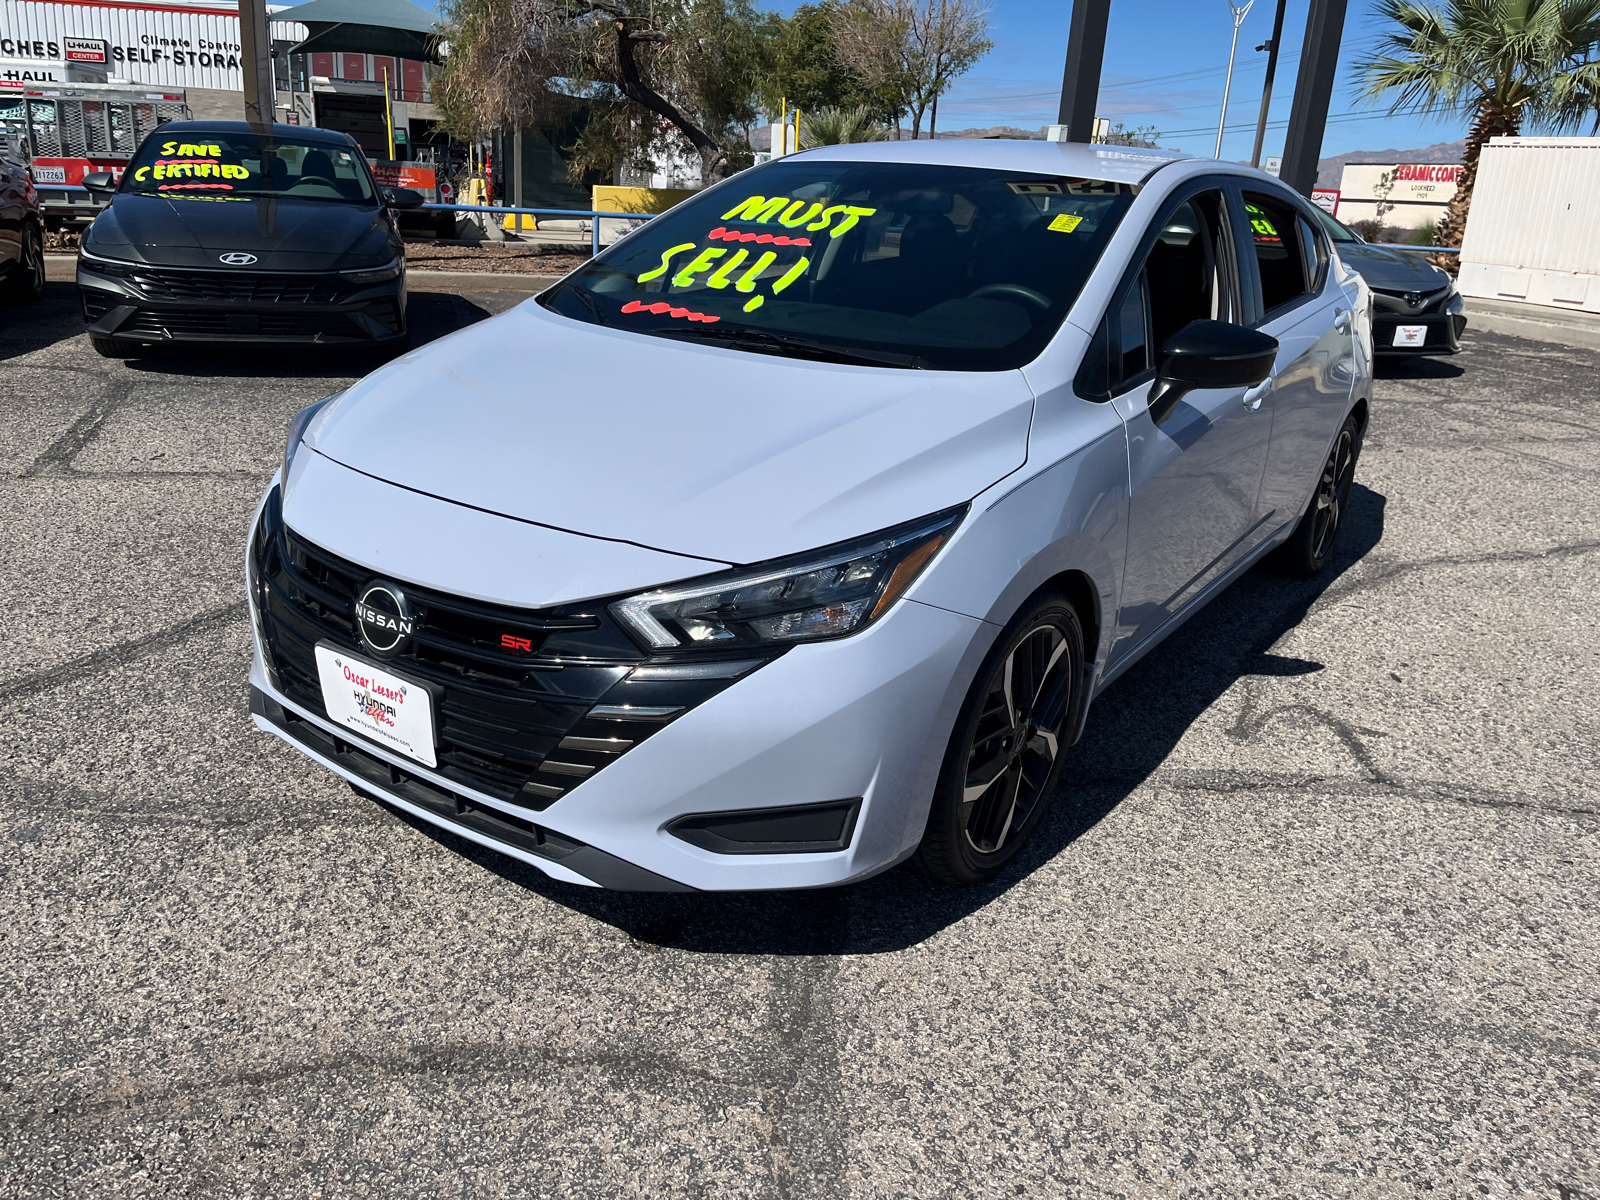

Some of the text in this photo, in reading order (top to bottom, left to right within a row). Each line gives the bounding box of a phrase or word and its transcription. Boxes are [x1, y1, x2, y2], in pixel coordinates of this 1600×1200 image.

[1, 38, 59, 57] CHES
[67, 41, 102, 50] U-HAUL
[141, 34, 190, 47] Climate
[72, 52, 99, 60] CENTER
[112, 46, 243, 69] SELF-STORA
[0, 69, 58, 82] -HAUL
[160, 141, 221, 156] SAVE
[135, 163, 250, 181] CERTIFIED
[1396, 165, 1466, 183] CERAMIC COAT
[1411, 184, 1435, 192] LOCKHEED
[720, 195, 877, 238] MUST
[637, 242, 810, 312] SELL!
[355, 603, 412, 634] NISSAN
[501, 634, 532, 652] SR
[343, 665, 403, 704] Oscar Leeser's
[353, 689, 396, 718] HYUNDAI
